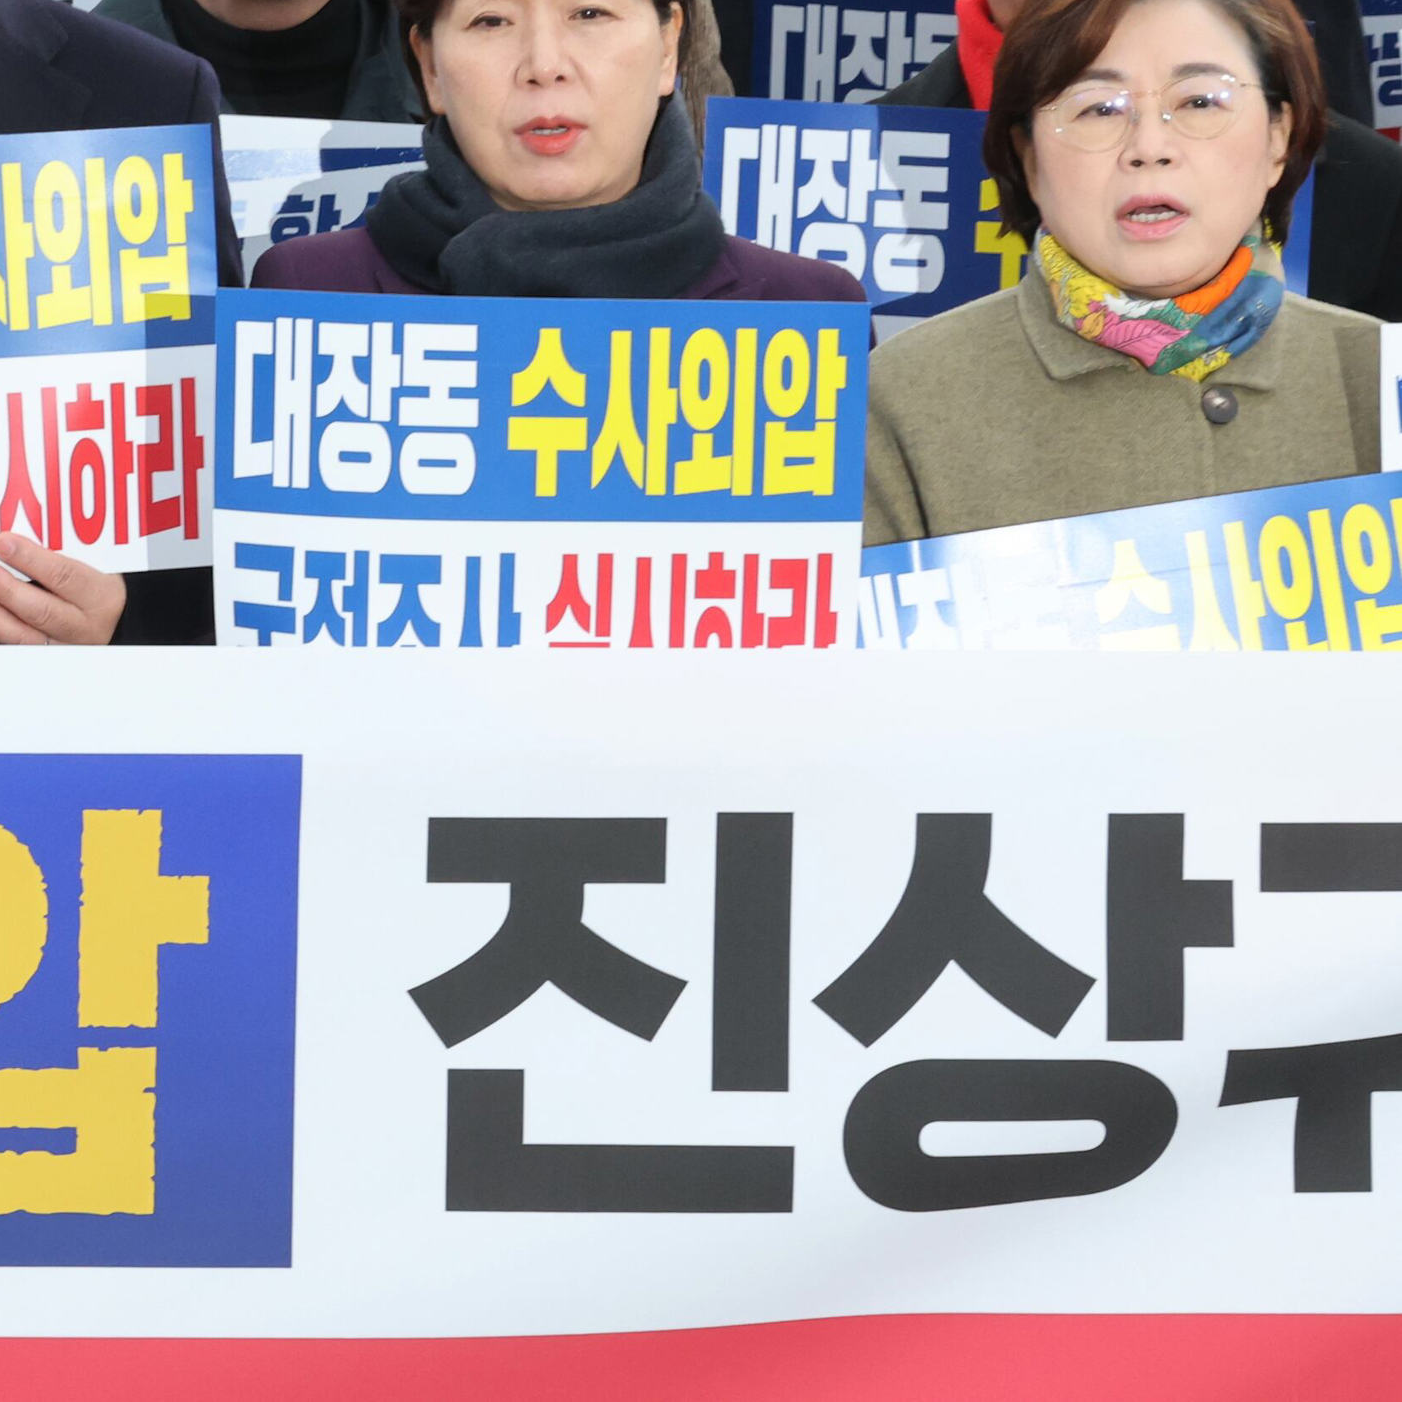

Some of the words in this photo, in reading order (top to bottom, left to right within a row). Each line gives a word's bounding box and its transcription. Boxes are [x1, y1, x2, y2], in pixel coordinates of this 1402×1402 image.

[721, 124, 951, 294] 대장동
[233, 317, 479, 495] 대장동
[507, 327, 847, 497] 수사외압
